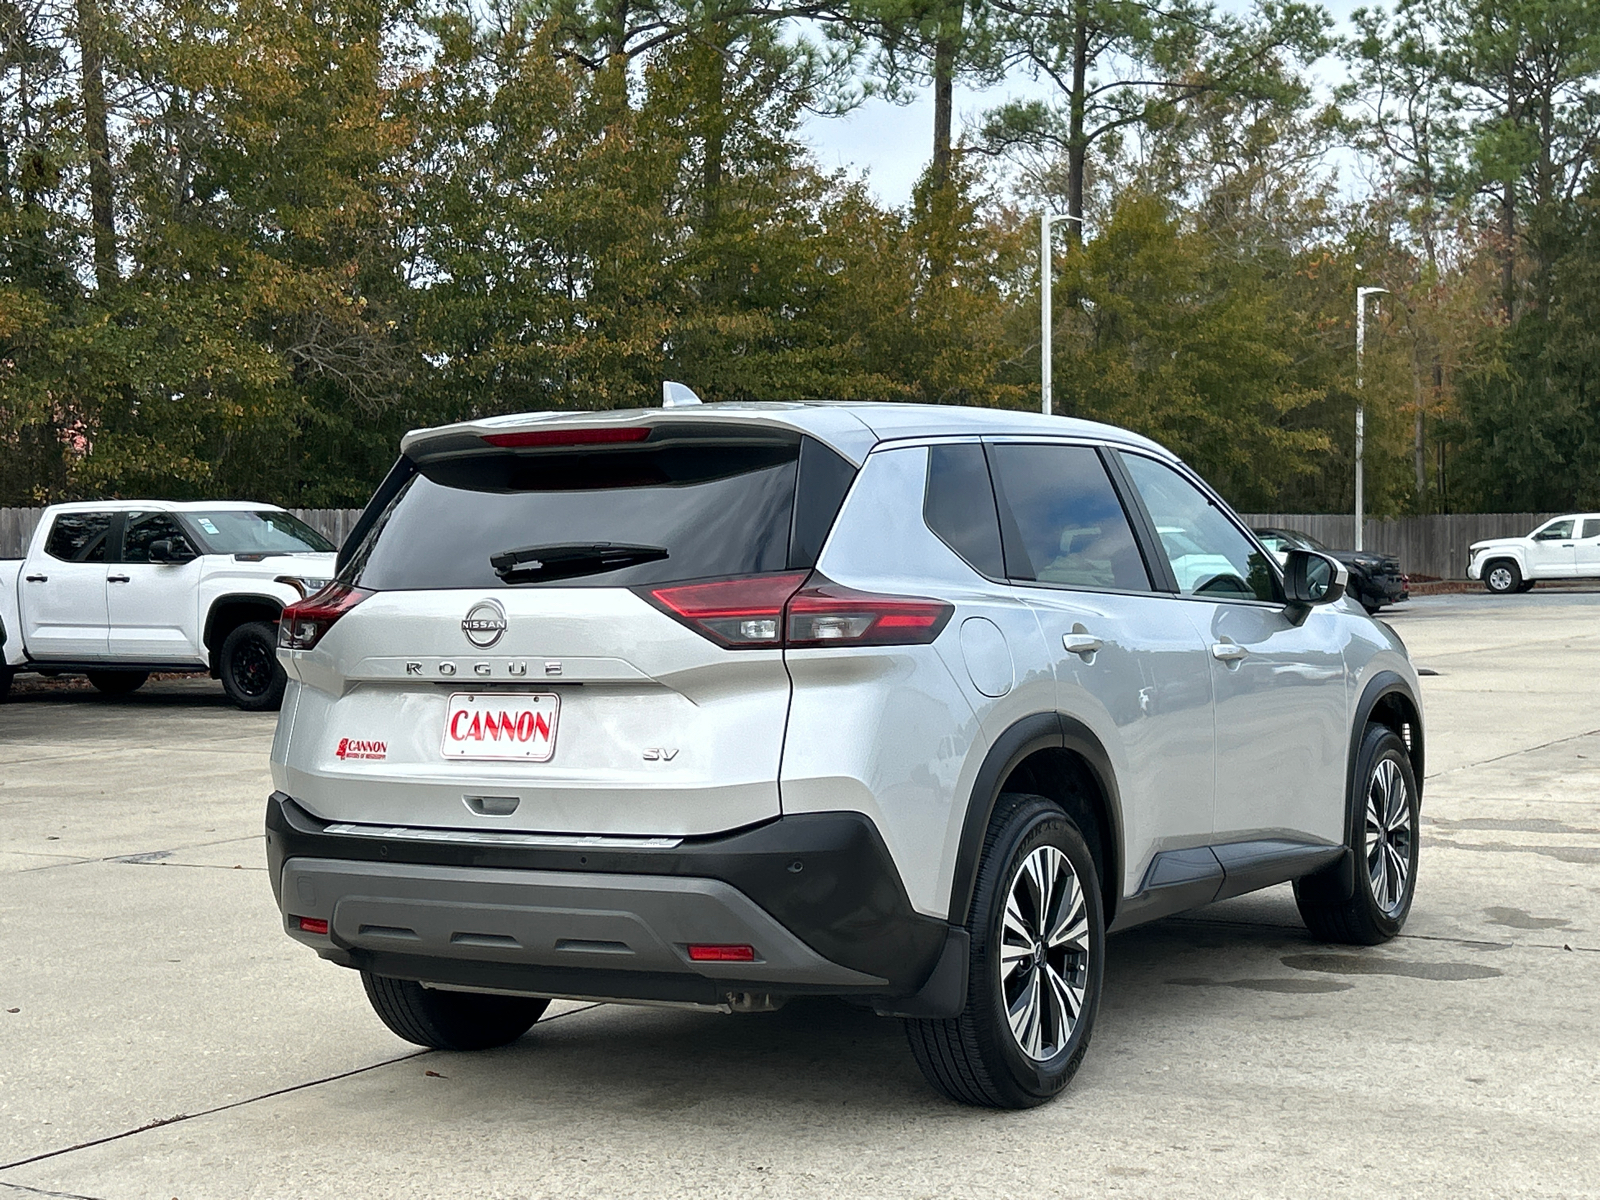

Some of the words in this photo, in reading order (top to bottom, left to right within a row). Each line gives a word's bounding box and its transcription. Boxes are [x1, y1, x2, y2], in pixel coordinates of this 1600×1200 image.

[462, 620, 506, 630] NISSAN
[406, 660, 563, 676] ROGUE
[450, 709, 553, 743] CANNON
[348, 740, 388, 753] CANNON
[642, 747, 680, 762] SV
